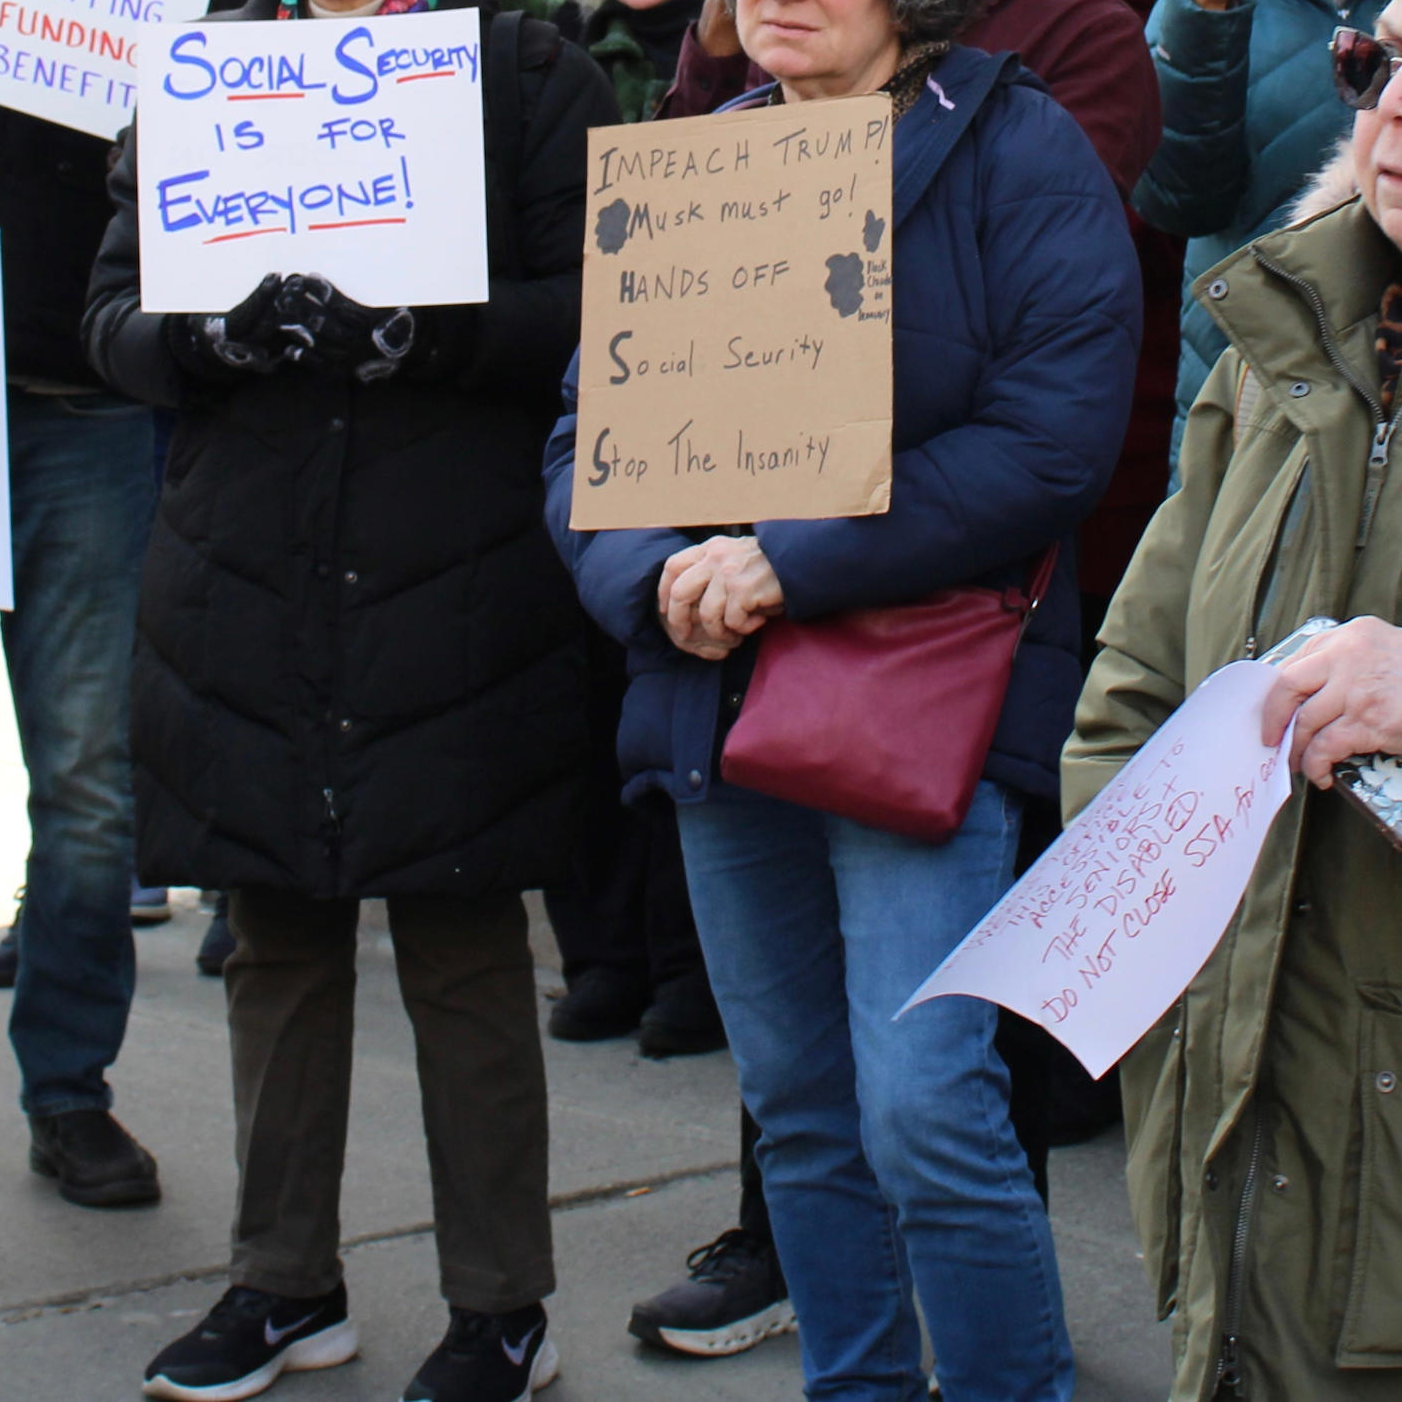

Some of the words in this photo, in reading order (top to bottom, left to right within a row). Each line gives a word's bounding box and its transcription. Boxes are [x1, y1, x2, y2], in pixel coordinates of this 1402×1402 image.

[163, 31, 326, 100] SOCIAL
[331, 26, 480, 106] SECURITY
[215, 120, 265, 151] IS
[317, 116, 406, 149] FOR
[593, 139, 751, 196] IMPEACH
[773, 115, 889, 166] TRUMP!
[156, 156, 414, 234] EVERYONE!
[628, 201, 705, 240] Musk
[720, 189, 792, 223] must
[818, 173, 857, 221] go!
[619, 263, 710, 305] HANDS
[731, 260, 790, 289] OFF
[608, 329, 694, 385] Social
[723, 334, 824, 371] Seurity
[587, 427, 649, 487] Stop
[667, 418, 717, 477] The
[736, 429, 830, 476] Insanity
[1030, 788, 1149, 929] ACCESSIBLE
[1041, 914, 1087, 964] THE
[1094, 791, 1204, 916] DISABLED.
[1065, 802, 1163, 910] SENIORS
[1041, 988, 1079, 1023] DO
[1078, 928, 1117, 990] NOT
[1122, 868, 1177, 939] CLOSE
[1183, 814, 1234, 868] SSA
